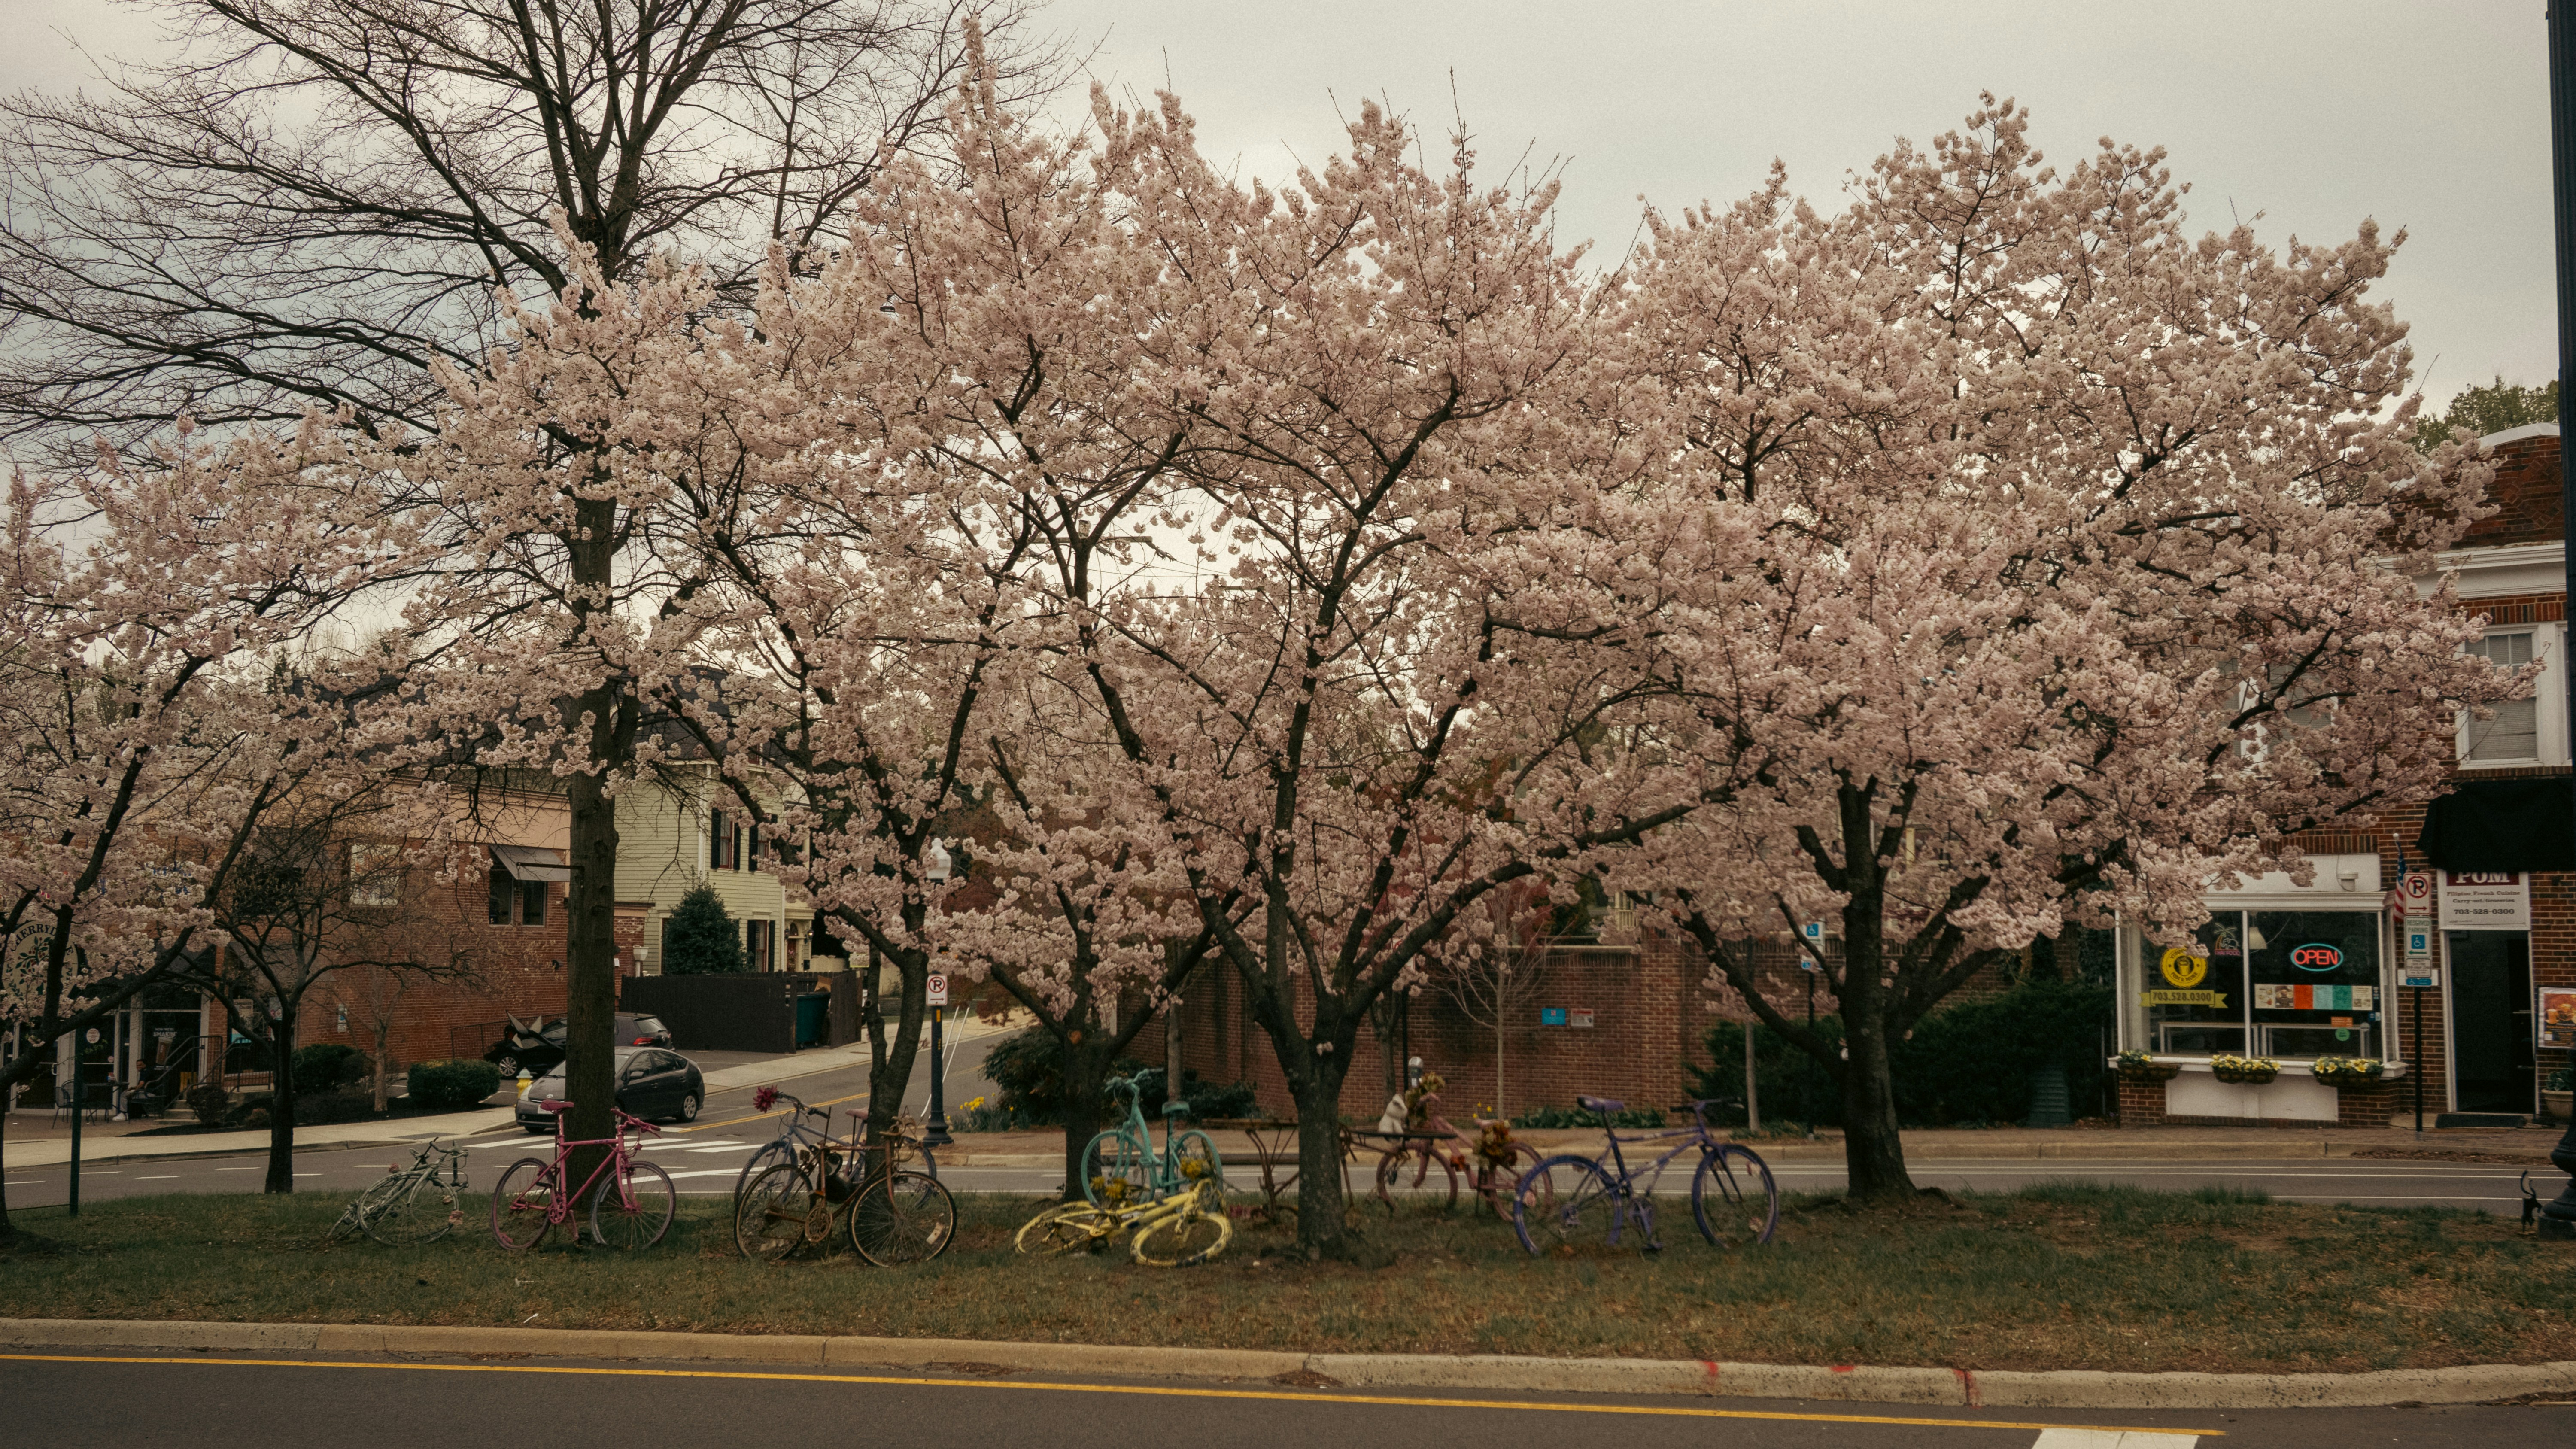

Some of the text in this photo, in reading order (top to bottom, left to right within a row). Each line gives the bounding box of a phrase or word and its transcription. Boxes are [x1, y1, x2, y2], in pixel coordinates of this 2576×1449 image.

[2456, 872, 2510, 883] POM
[2294, 949, 2338, 965] OPEN
[2153, 992, 2211, 1001] 703.528.0300
